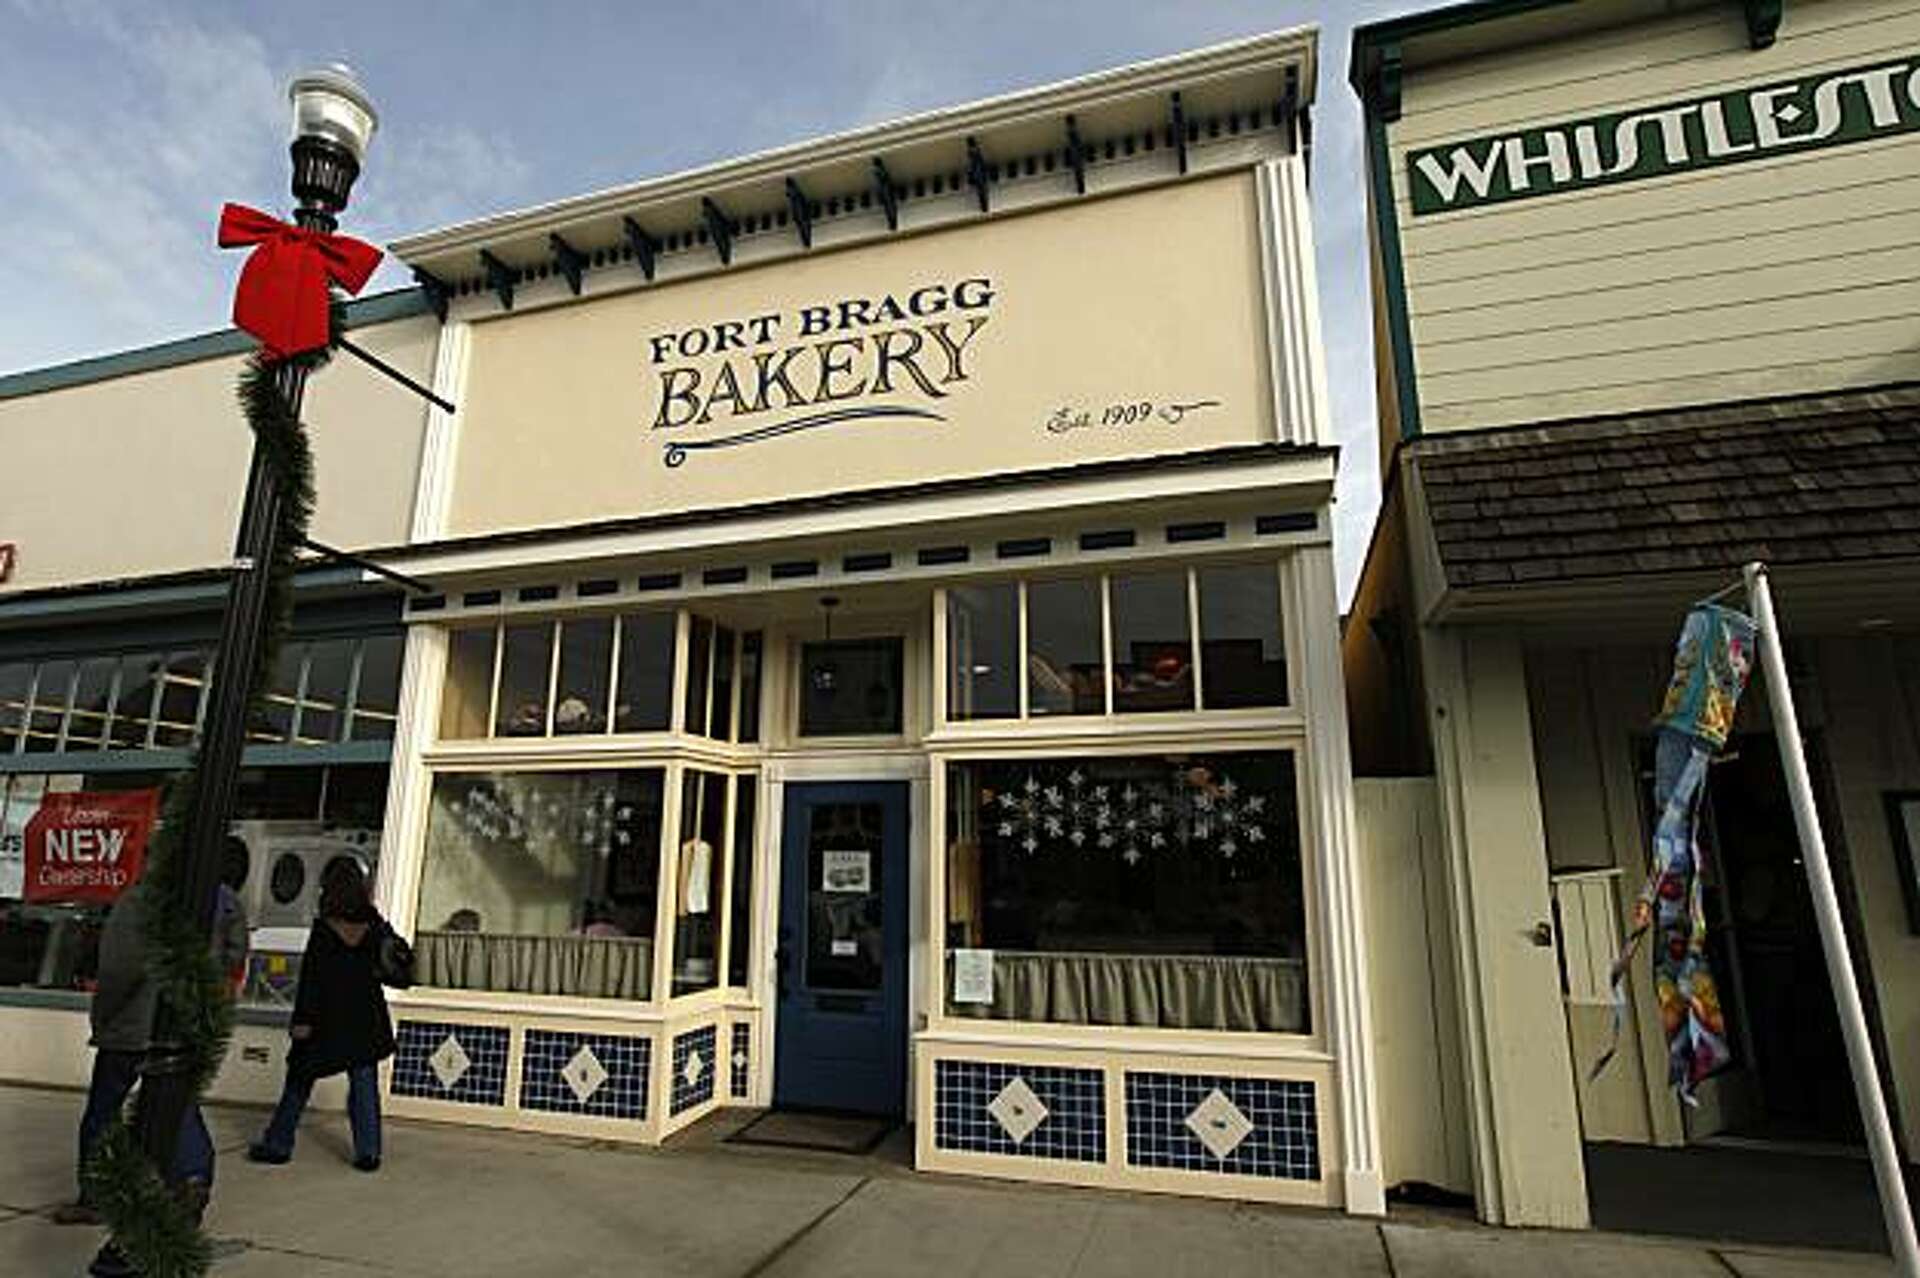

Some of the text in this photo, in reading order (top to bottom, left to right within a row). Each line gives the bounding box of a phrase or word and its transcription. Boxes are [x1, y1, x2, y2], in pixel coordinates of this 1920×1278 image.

[1415, 64, 1920, 201] WHISTLEST
[650, 278, 996, 364] FORT BRAGG
[650, 316, 988, 431] BAKERY
[1101, 402, 1154, 425] 1909
[44, 828, 127, 863] NEW
